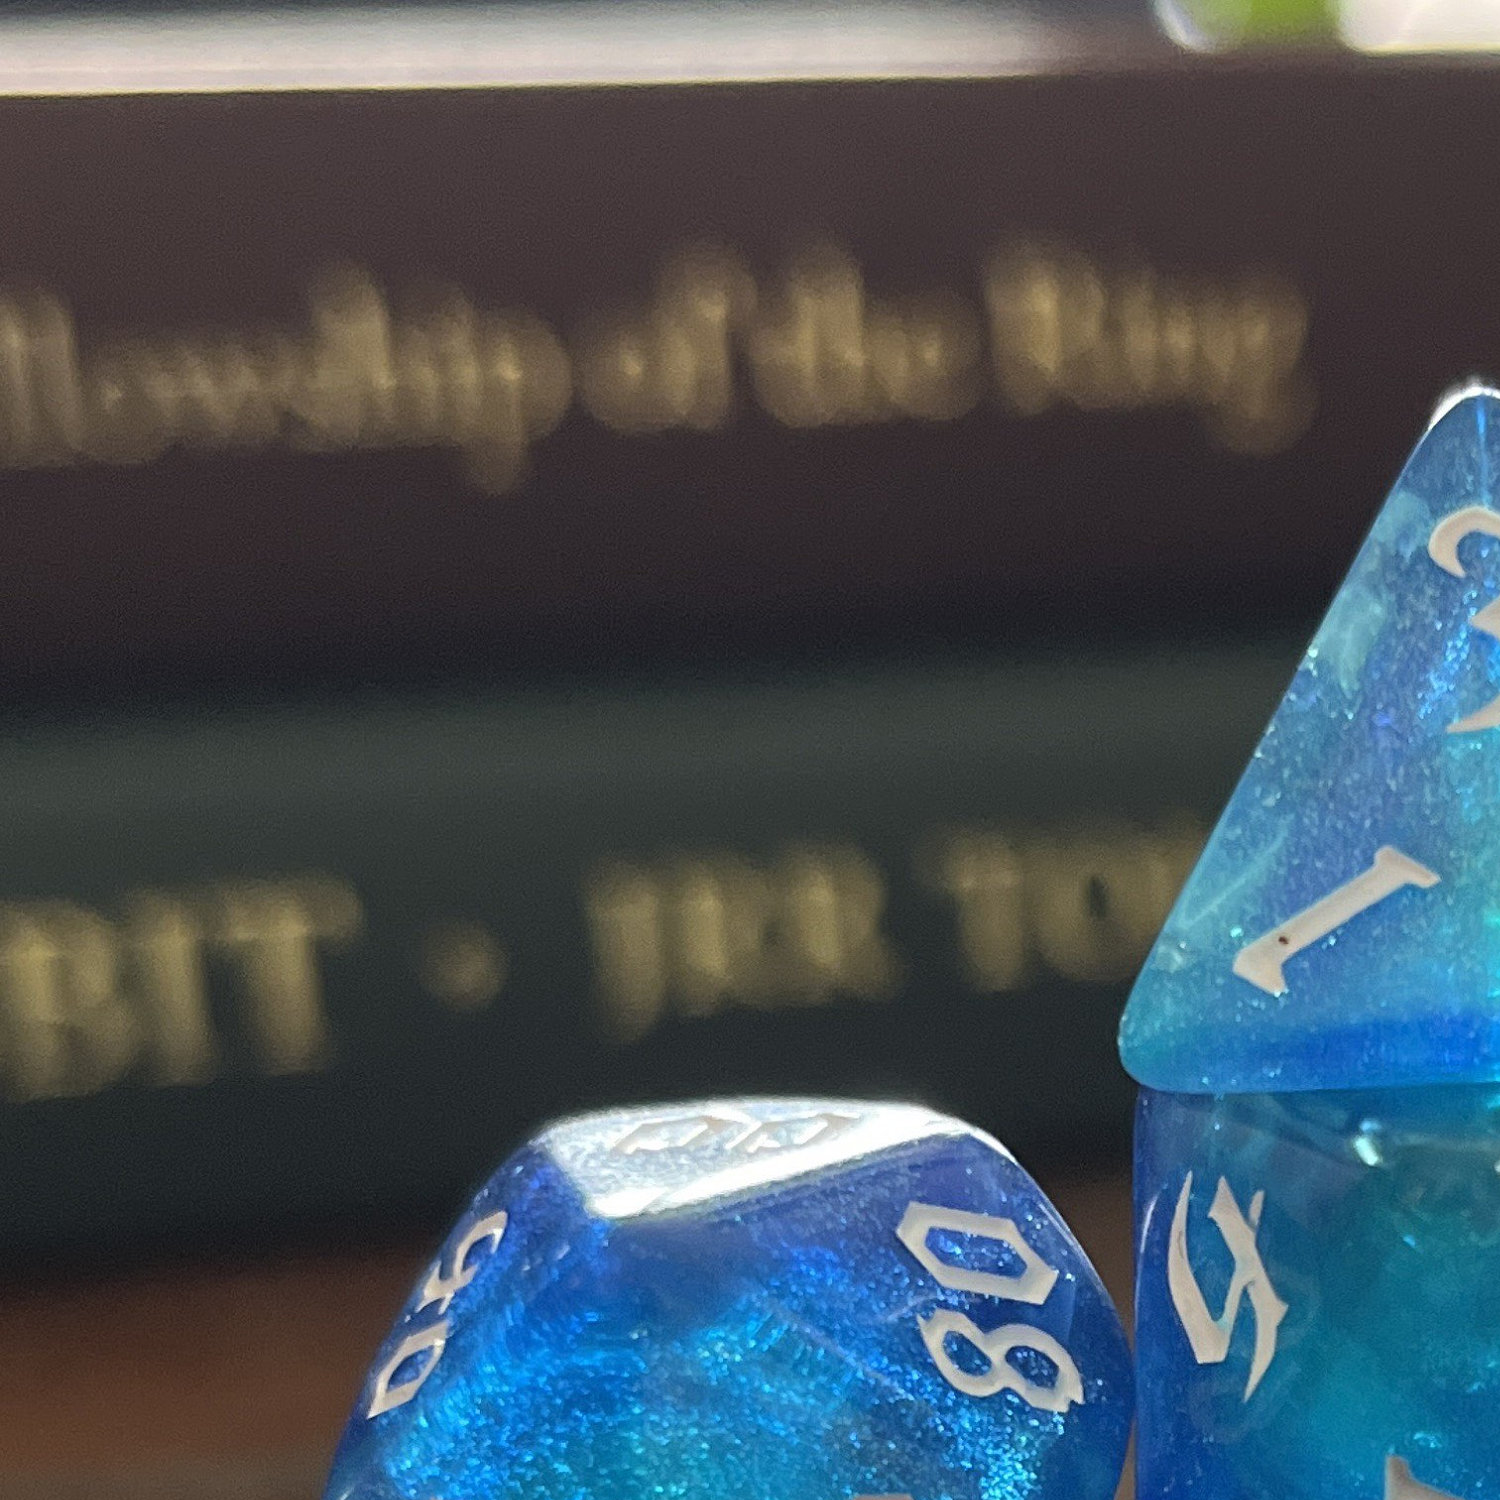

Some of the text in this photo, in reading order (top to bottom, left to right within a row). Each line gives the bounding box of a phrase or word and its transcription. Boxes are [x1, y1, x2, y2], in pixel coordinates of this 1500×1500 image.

[1233, 845, 1441, 994] 1
[895, 1201, 1084, 1414] 80
[1167, 1169, 1288, 1402] 4
